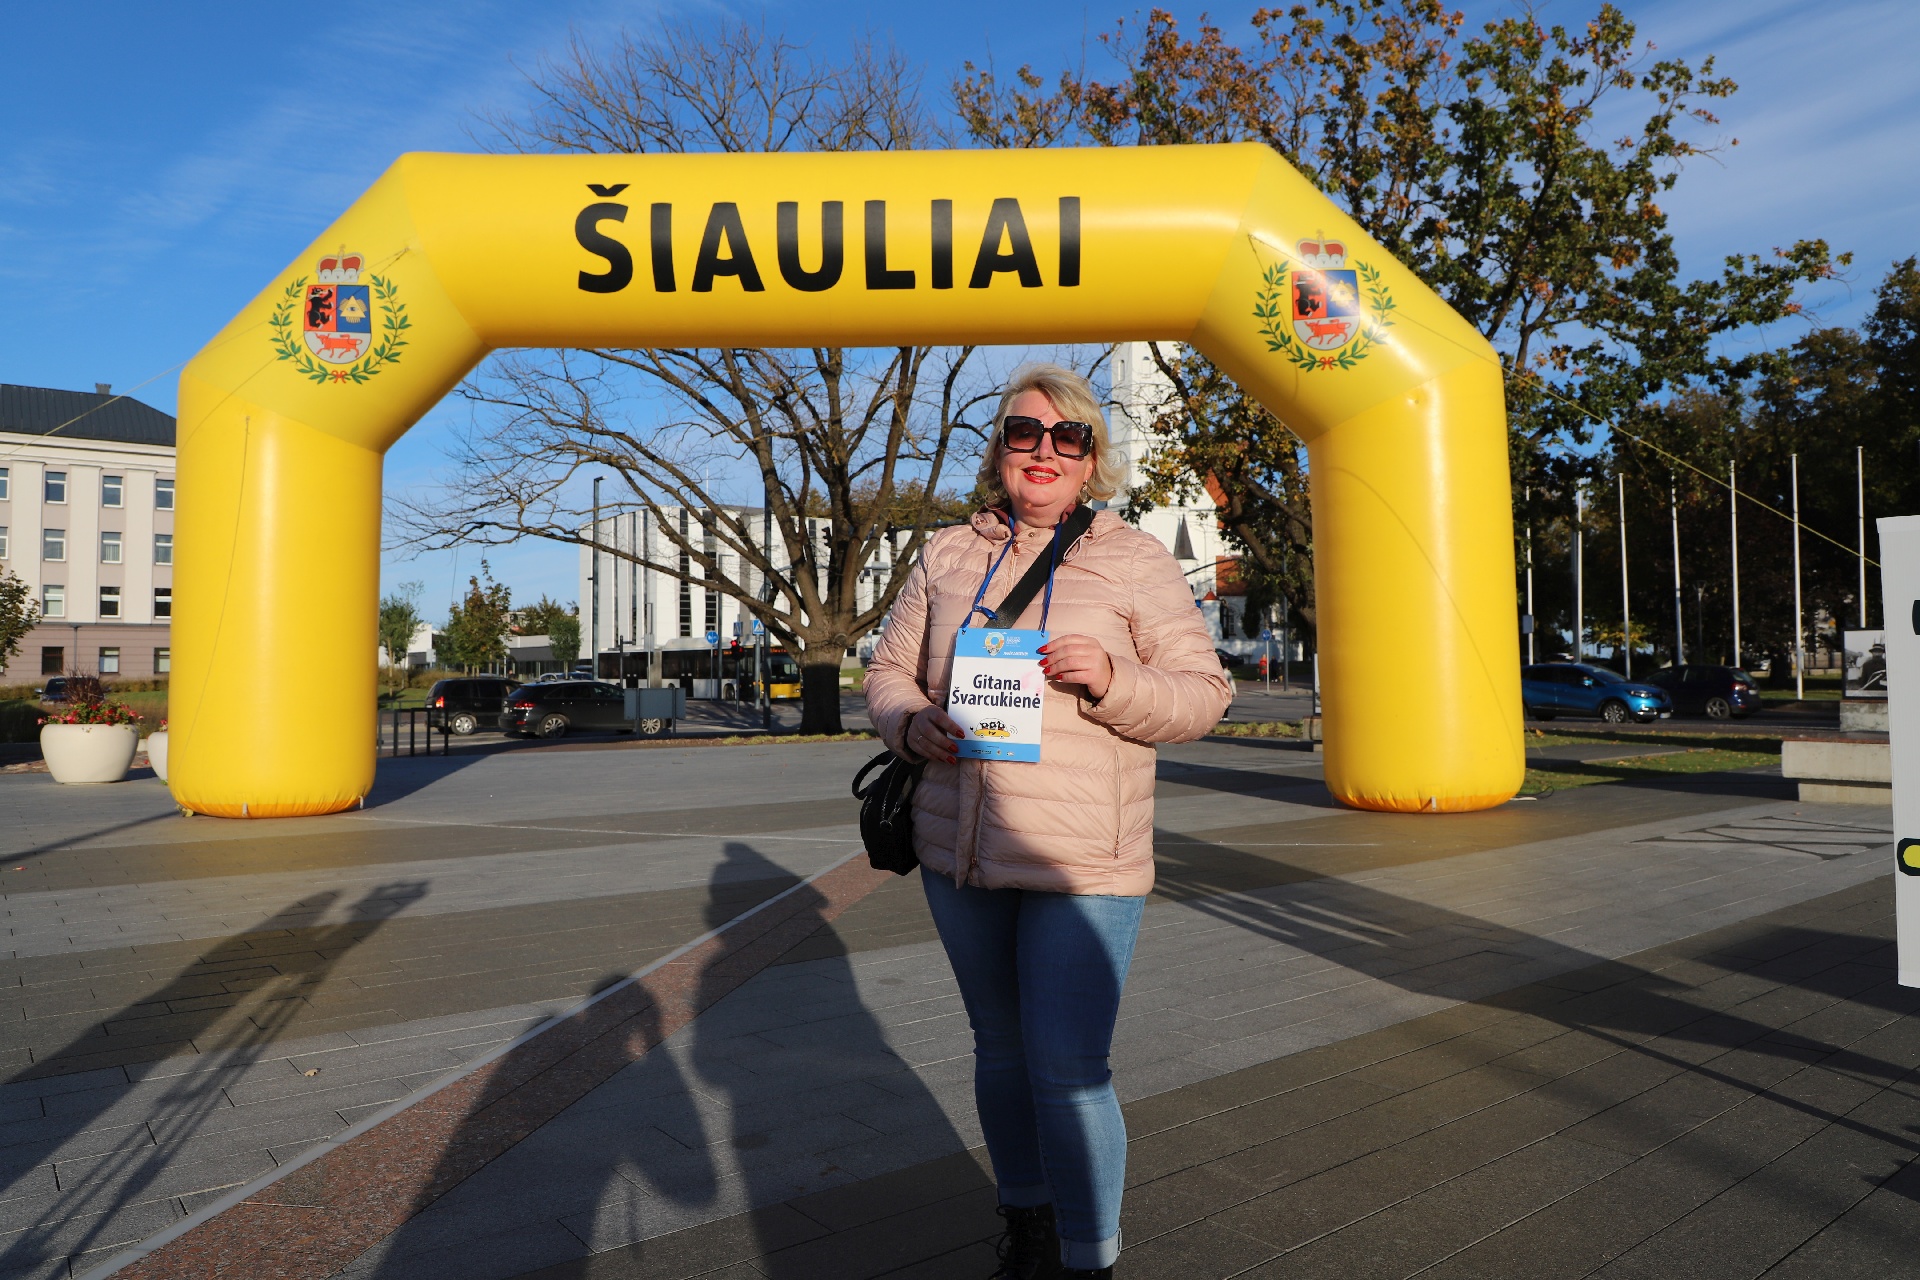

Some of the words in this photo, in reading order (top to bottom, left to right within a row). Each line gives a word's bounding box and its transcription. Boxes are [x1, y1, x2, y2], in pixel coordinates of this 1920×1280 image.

[575, 183, 1081, 294] ŠIAULIAI
[973, 674, 1021, 691] Gitana
[951, 686, 1041, 709] Švarcukienė
